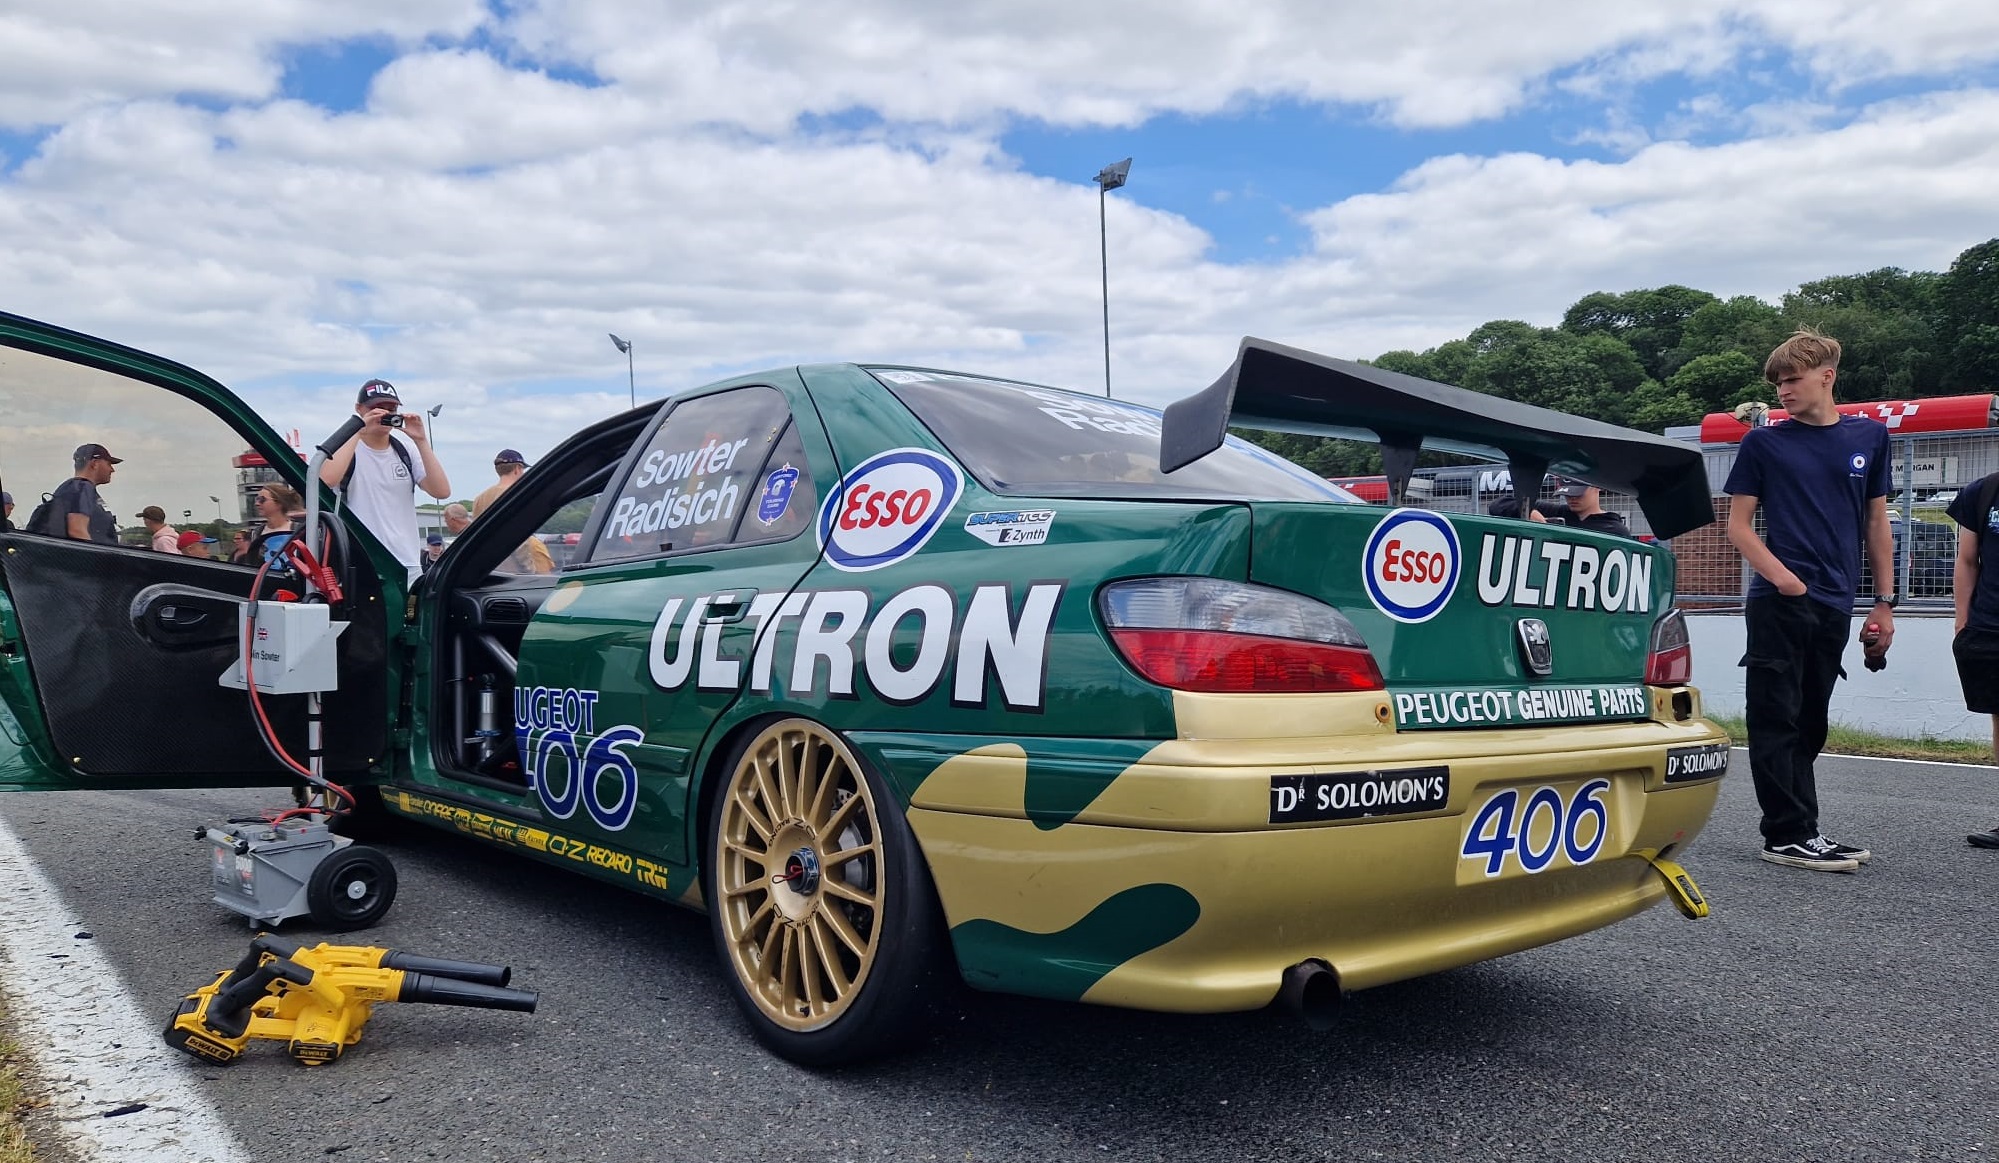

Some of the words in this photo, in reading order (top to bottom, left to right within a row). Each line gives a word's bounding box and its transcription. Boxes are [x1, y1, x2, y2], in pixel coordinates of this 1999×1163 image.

[366, 384, 396, 397] FILA
[636, 437, 749, 489] Sowter
[607, 476, 739, 539] Radisich
[1012, 529, 1045, 542] Zynth
[1477, 532, 1653, 613] ULTRON
[649, 581, 1066, 711] ULTRON
[1396, 691, 1513, 724] PEUGEOT
[1517, 689, 1596, 720] GENUINE
[1599, 687, 1646, 716] PARTS
[1682, 751, 1728, 774] SOLOMON'S
[1317, 776, 1444, 811] SOLOMON'S
[1461, 778, 1611, 877] 406
[587, 845, 633, 873] RECARO
[636, 858, 668, 890] TRW
